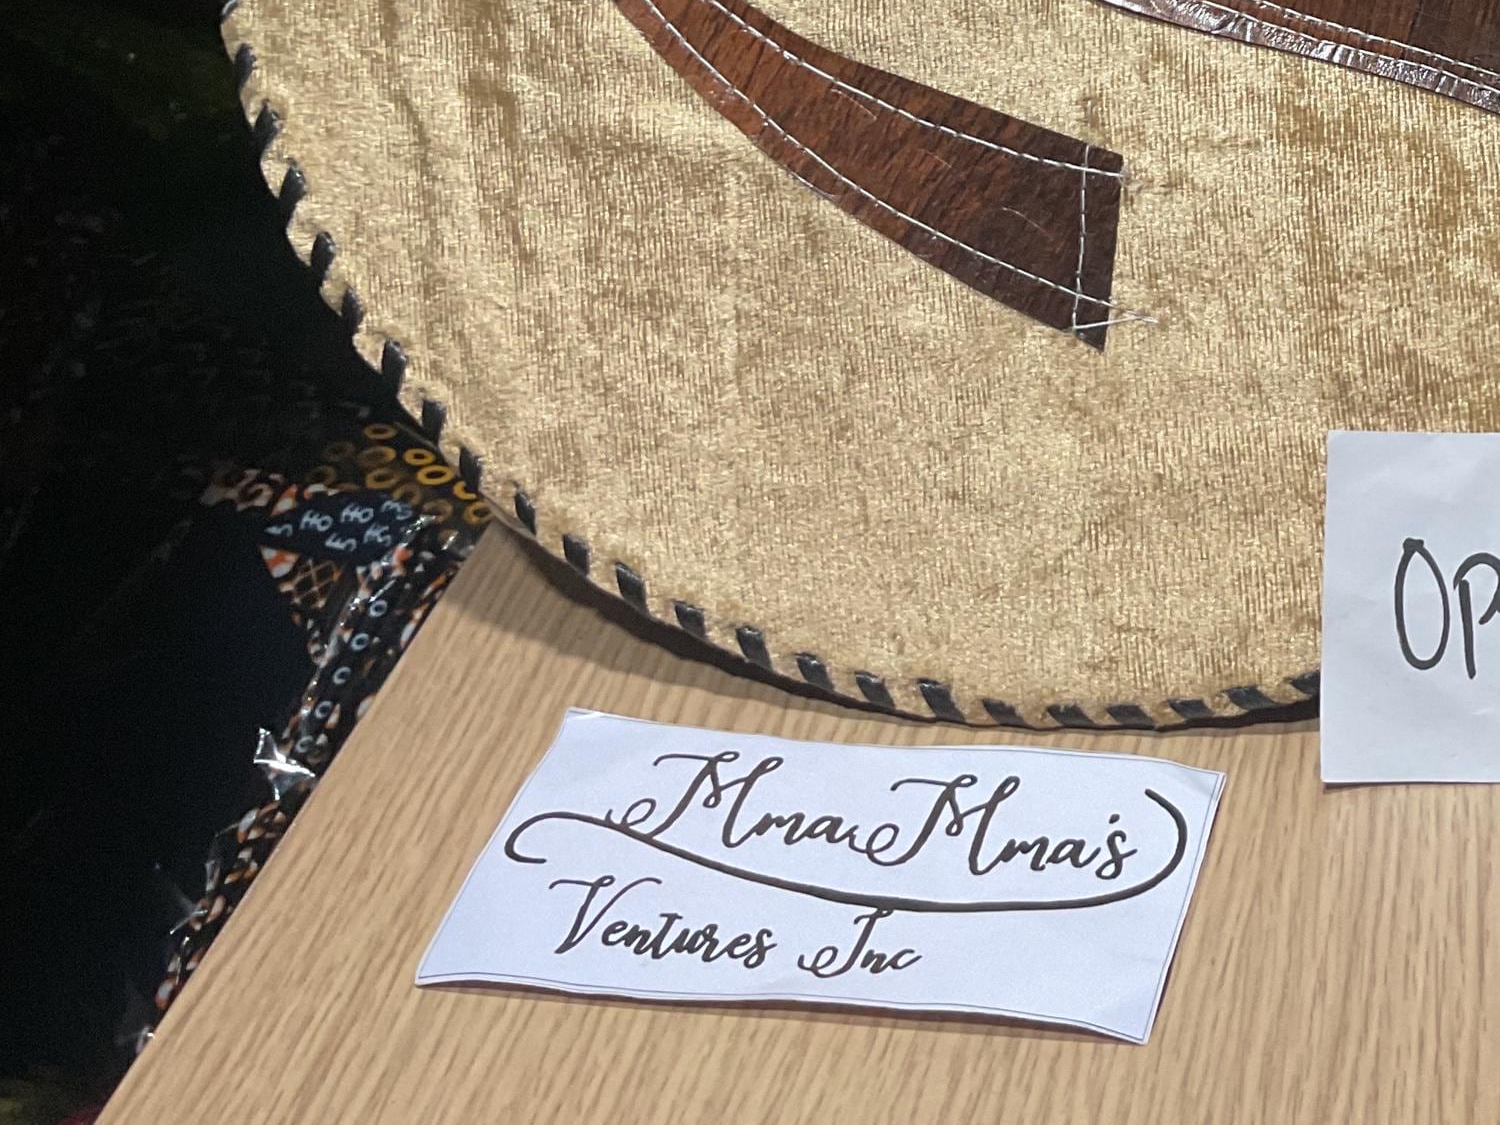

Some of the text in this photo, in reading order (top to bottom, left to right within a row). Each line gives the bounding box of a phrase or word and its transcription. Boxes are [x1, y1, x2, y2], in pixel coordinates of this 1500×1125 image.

[604, 750, 1139, 878] Mma Mma's
[548, 874, 923, 979] Ventures Inc
